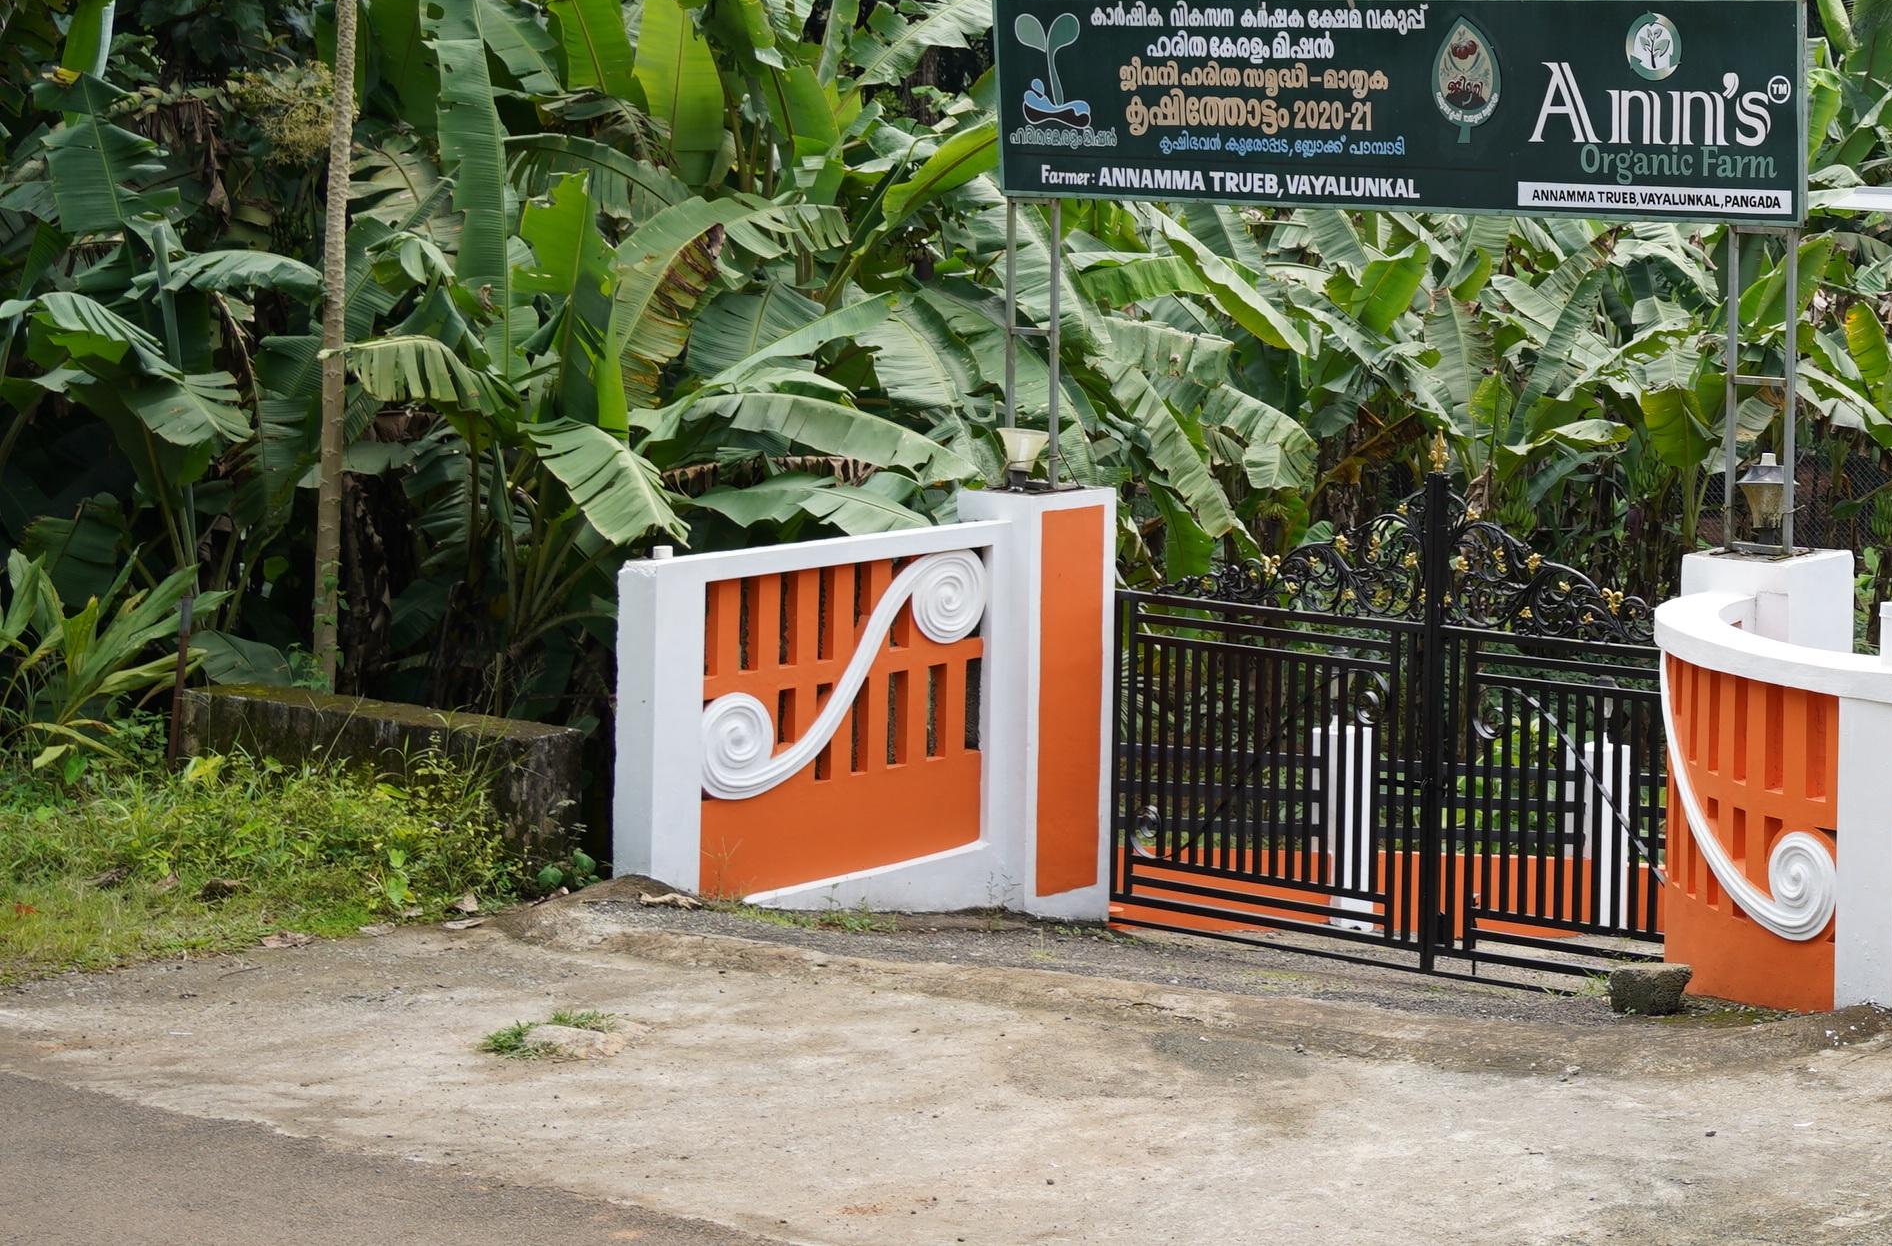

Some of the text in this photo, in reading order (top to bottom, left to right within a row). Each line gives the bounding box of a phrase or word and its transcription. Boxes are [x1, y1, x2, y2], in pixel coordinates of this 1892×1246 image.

[1170, 0, 1234, 27] വികസന
[1147, 30, 1207, 58] ഹരിത
[1181, 60, 1241, 88] ഹരിത
[1293, 100, 1372, 131] 2020-21
[1528, 62, 1772, 146] Ann's
[1581, 143, 1777, 185] Organic Farm
[1041, 164, 1095, 187] Farmer:
[1098, 166, 1204, 192] ANNAMMA
[1286, 174, 1420, 198] VAYALUNKAL
[1532, 189, 1595, 203] ANNAMMA
[1725, 195, 1781, 209] PANGADA
